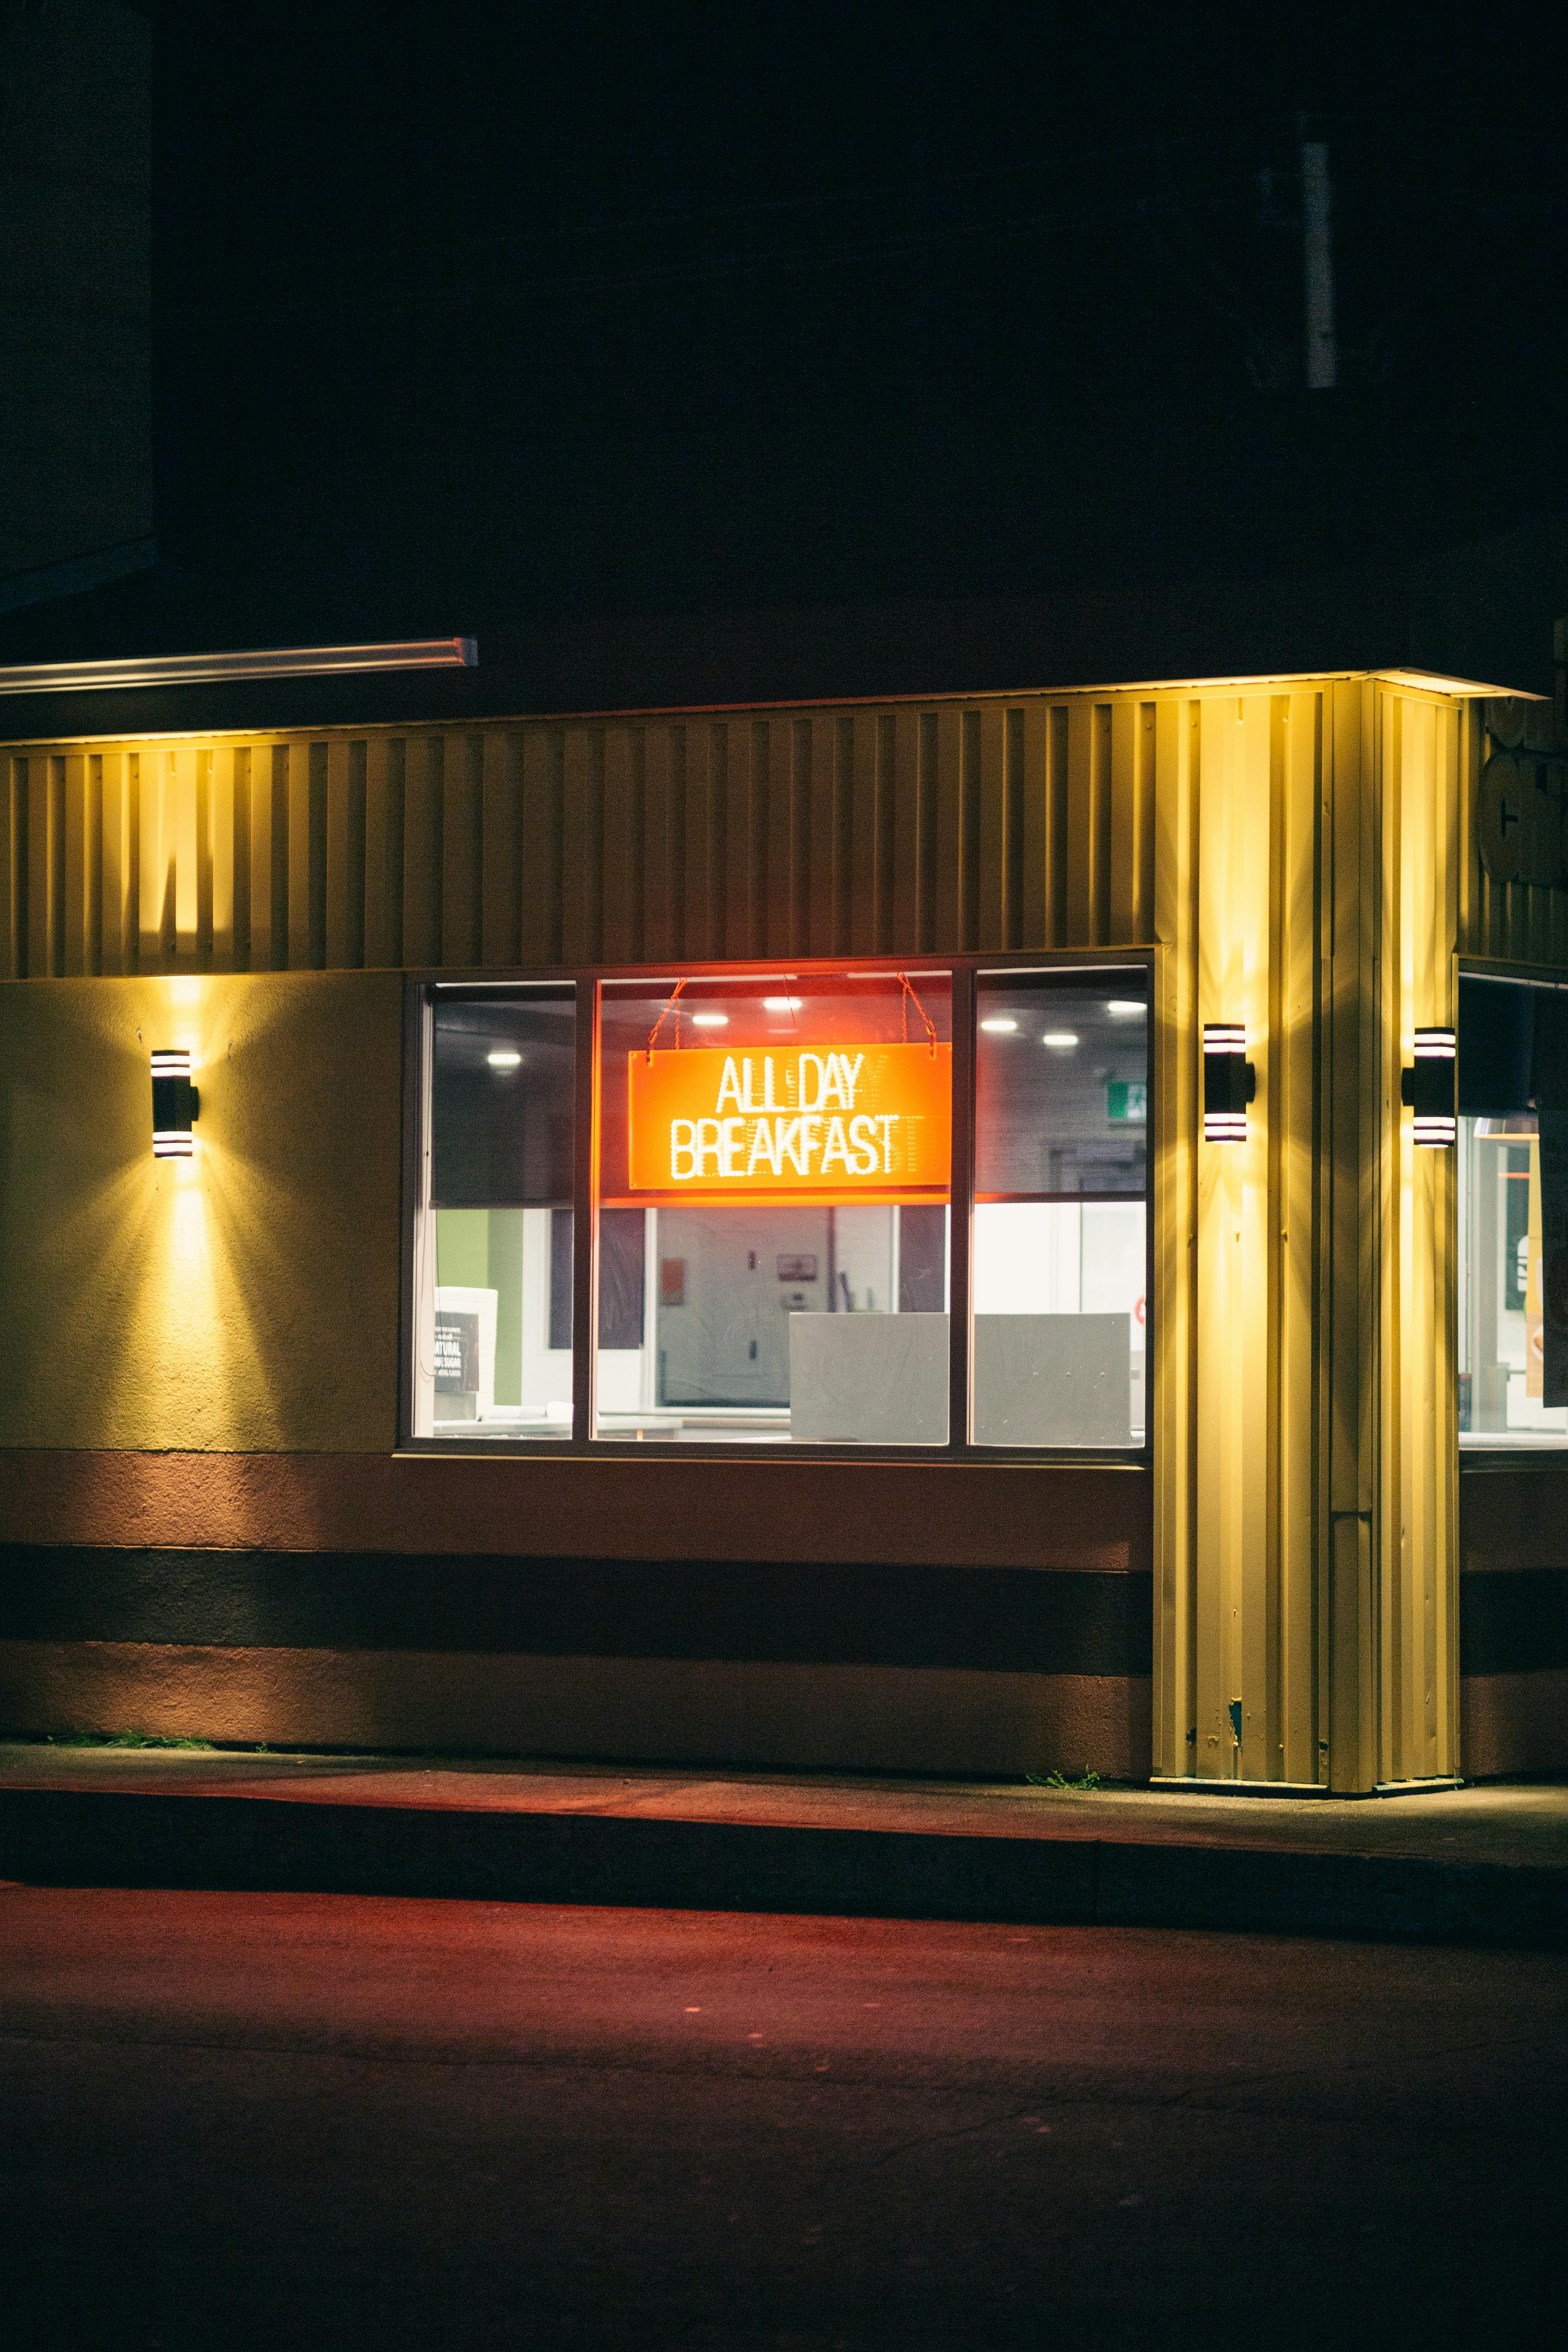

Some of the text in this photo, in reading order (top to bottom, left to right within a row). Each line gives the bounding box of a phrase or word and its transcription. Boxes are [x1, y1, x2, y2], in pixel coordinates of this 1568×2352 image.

[715, 1052, 864, 1113] ALL DAY
[671, 1114, 899, 1180] BREAKFAST
[434, 1341, 461, 1356] ATURAL
[434, 1356, 461, 1368] ANE SUGAR
